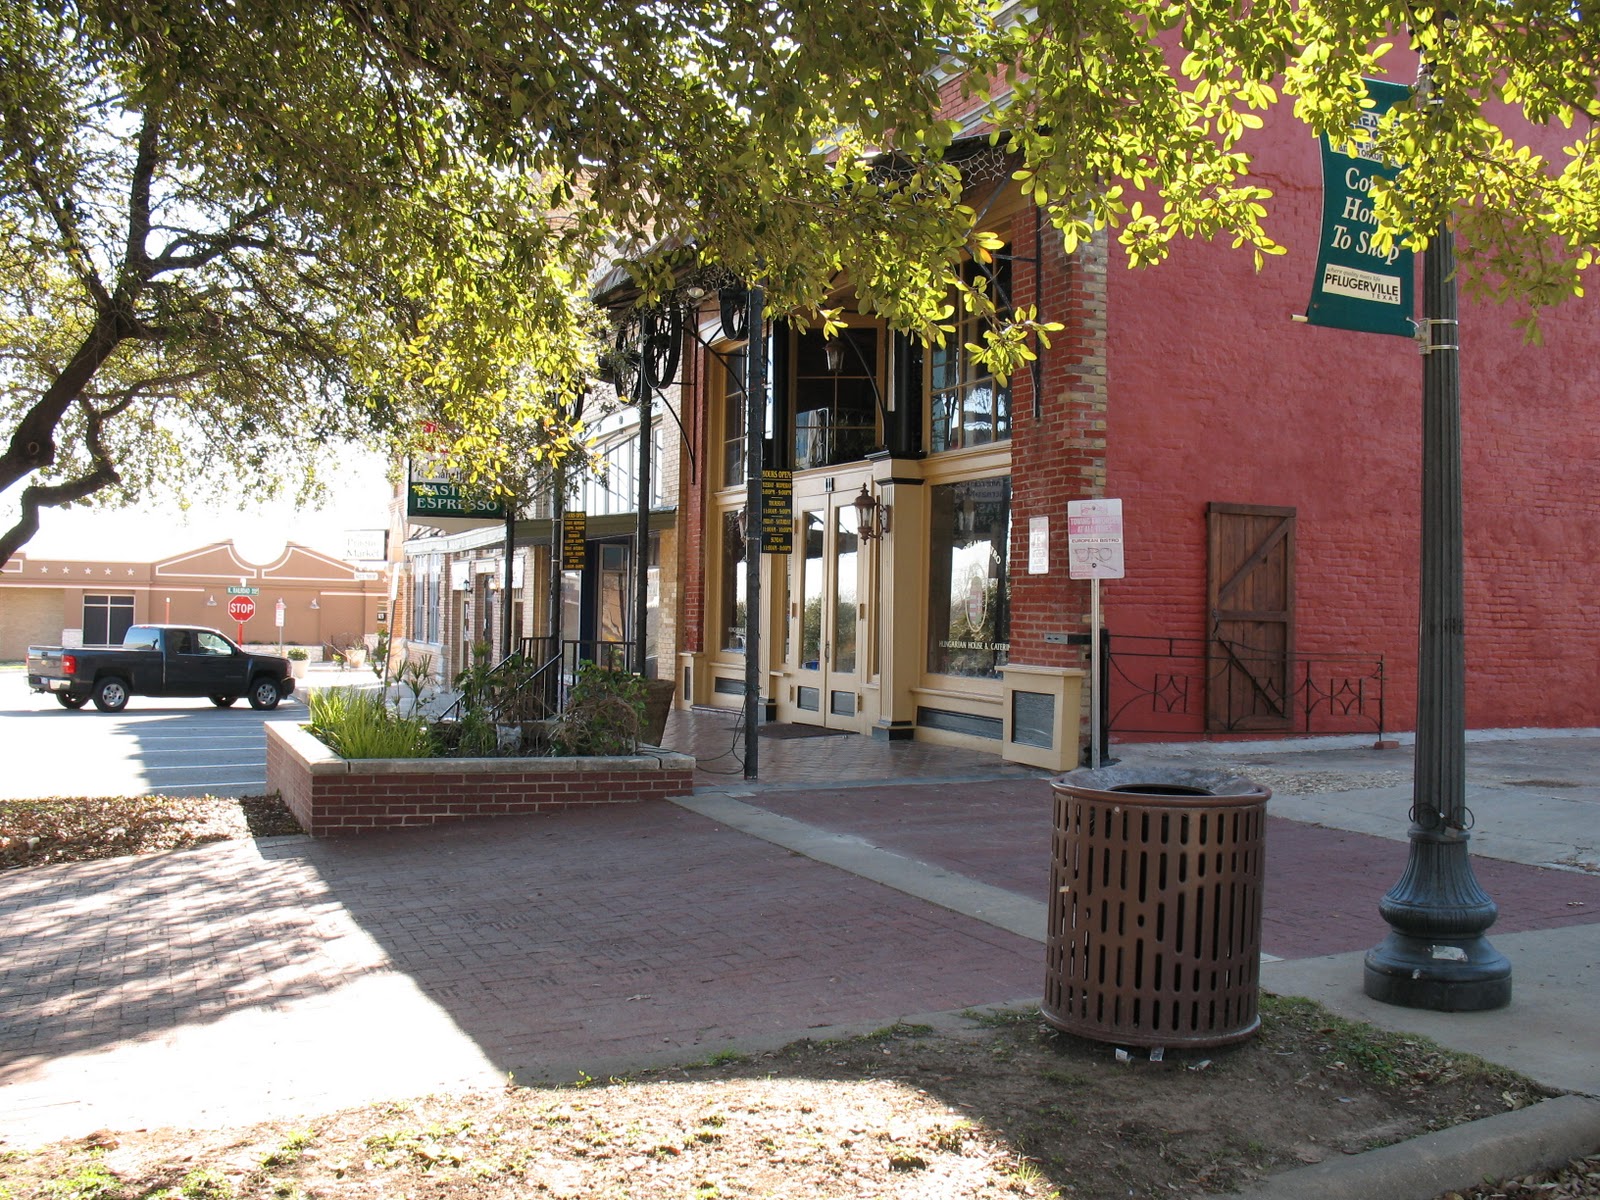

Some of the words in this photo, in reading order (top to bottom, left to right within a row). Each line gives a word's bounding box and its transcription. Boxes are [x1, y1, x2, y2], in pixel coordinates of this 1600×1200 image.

[1345, 167, 1376, 192] Co
[1341, 196, 1381, 225] Hom
[1331, 224, 1351, 250] To
[1324, 273, 1399, 296] PFLUGERVILLE
[1371, 292, 1399, 302] TEXAS
[346, 549, 380, 558] Market
[230, 603, 254, 614] STOP
[938, 640, 967, 649] HUNGARIAN
[967, 641, 984, 650] HOUSE
